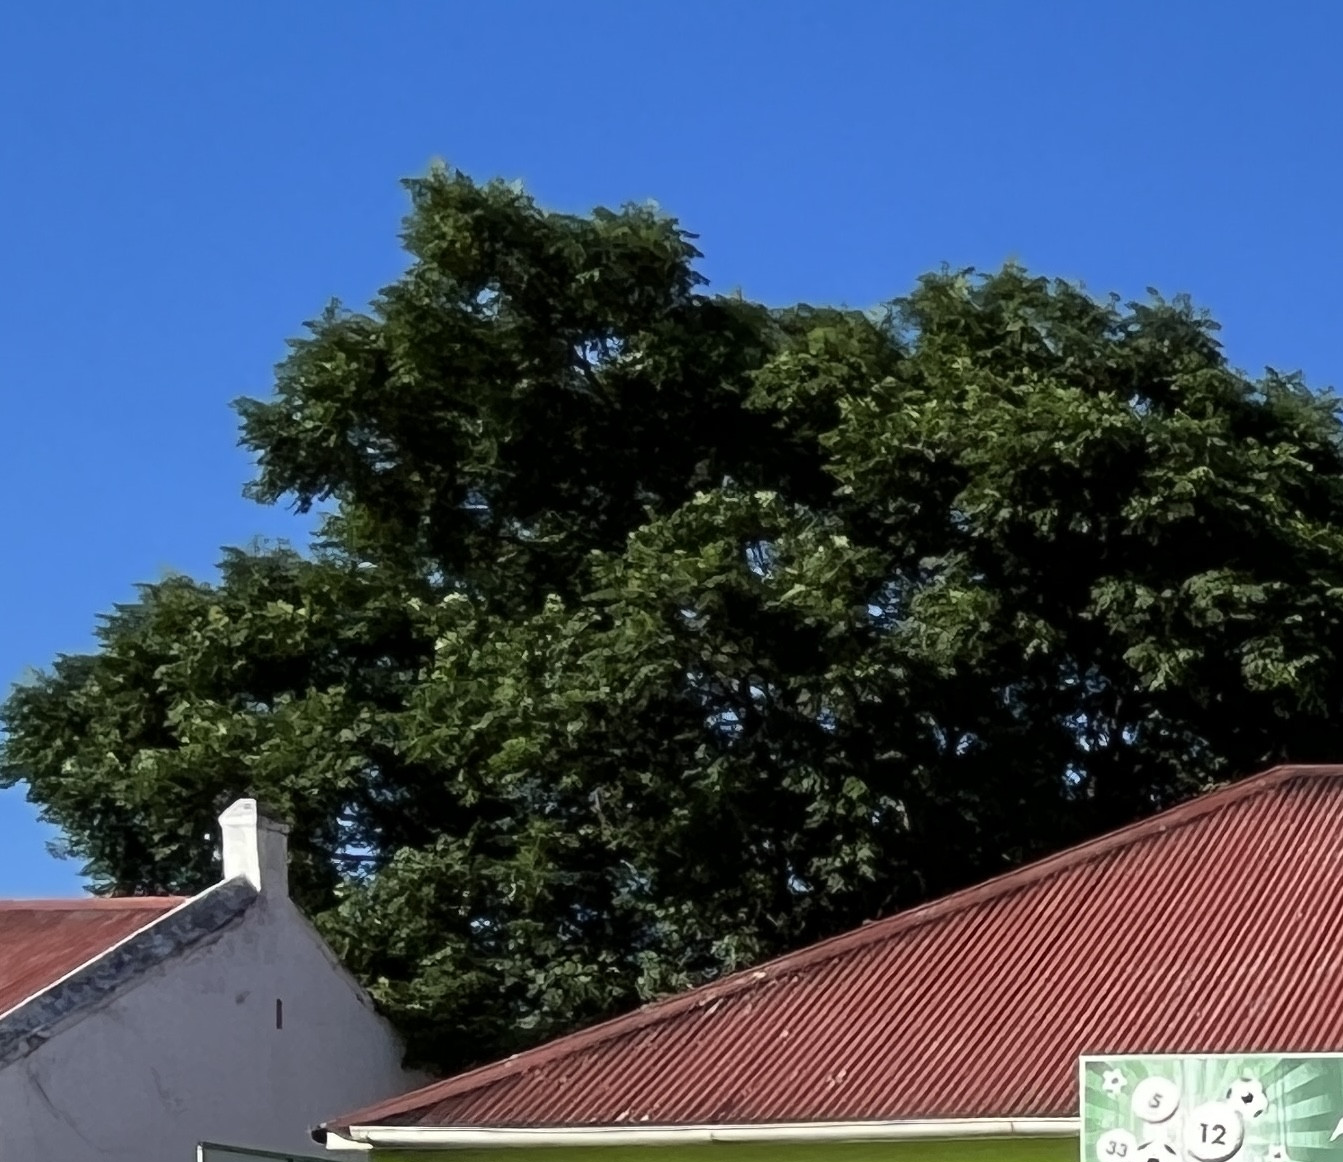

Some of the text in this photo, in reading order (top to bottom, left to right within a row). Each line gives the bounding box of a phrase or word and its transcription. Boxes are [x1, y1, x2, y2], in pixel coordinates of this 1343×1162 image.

[1149, 1093, 1163, 1109] 5
[1200, 1122, 1227, 1145] 12
[1106, 1140, 1127, 1157] 33
